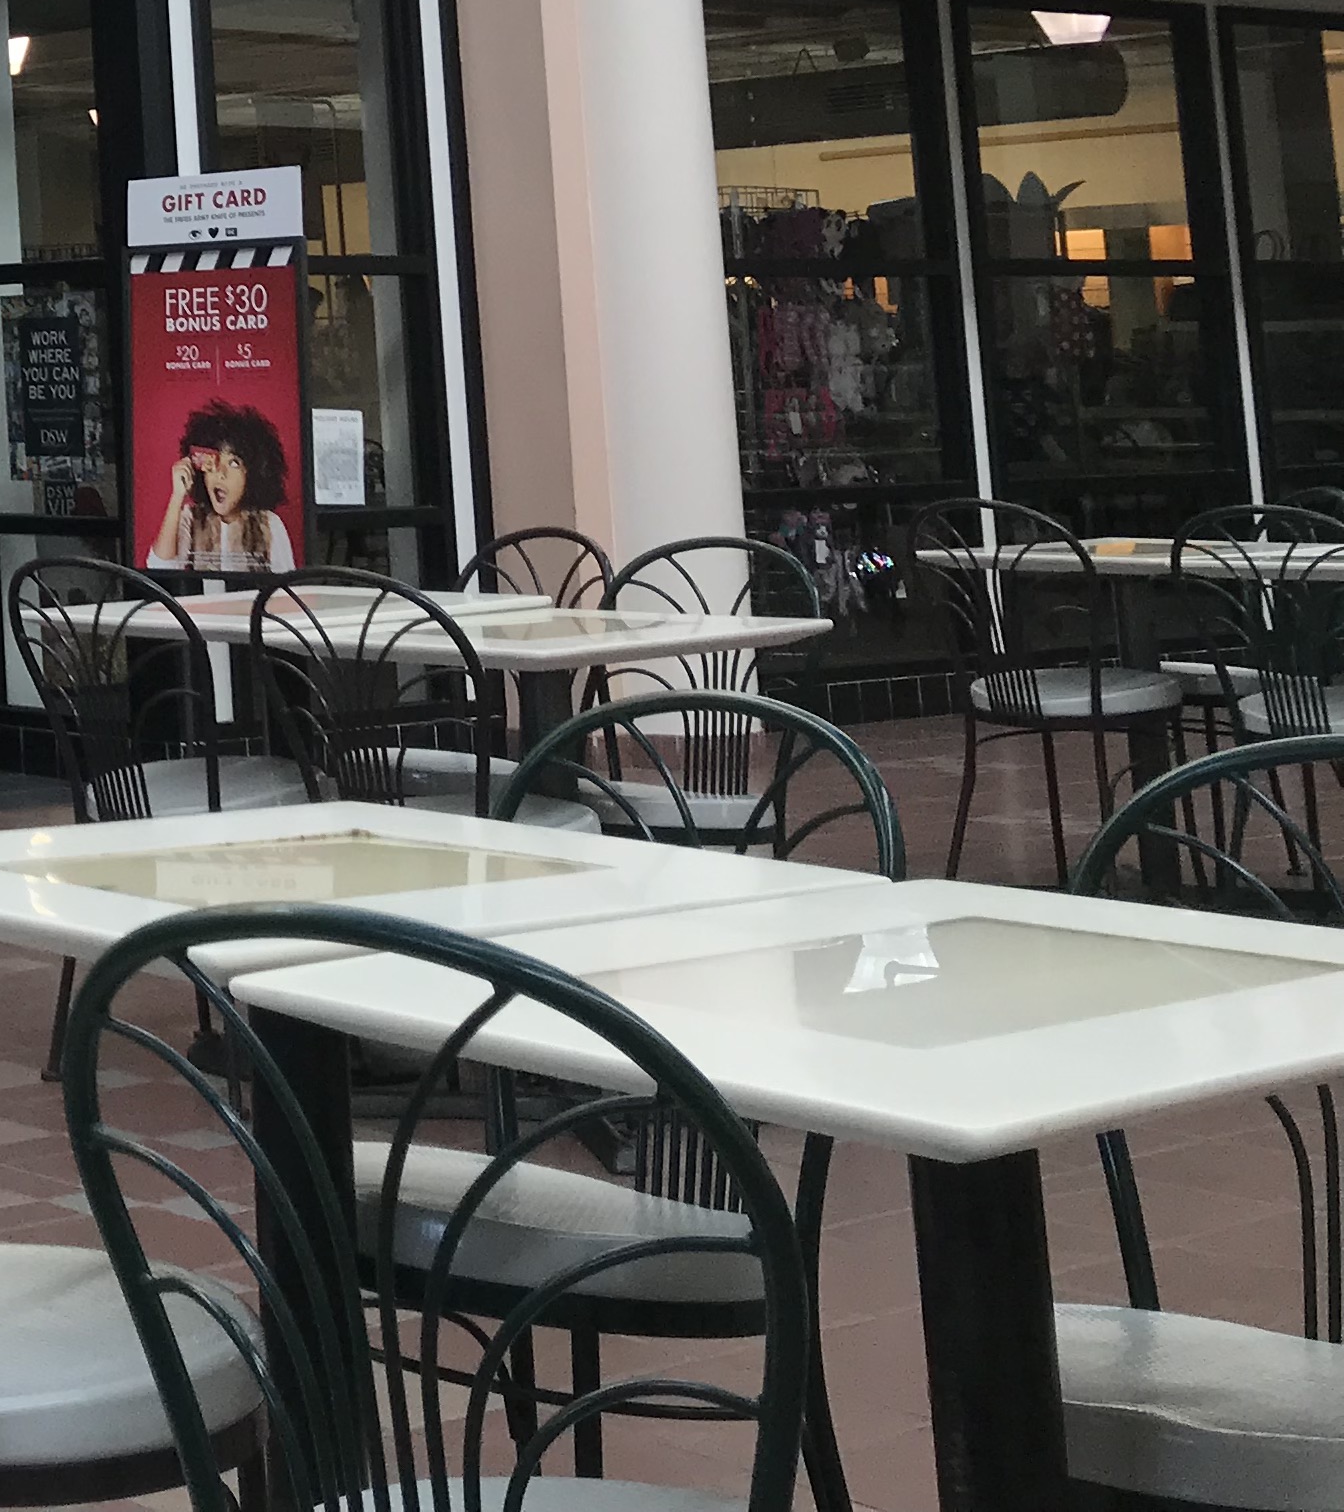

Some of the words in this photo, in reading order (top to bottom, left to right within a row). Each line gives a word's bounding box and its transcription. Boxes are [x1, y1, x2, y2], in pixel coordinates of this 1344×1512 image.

[162, 192, 205, 212] GIFT
[212, 187, 267, 209] CARD
[165, 286, 221, 316] FREE
[225, 283, 268, 314] $30
[165, 316, 221, 332] BONUS
[226, 314, 269, 330] CARD
[30, 330, 69, 346] WORK
[27, 348, 72, 364] WHERE
[176, 344, 200, 361] $20
[237, 343, 253, 360] $5
[22, 367, 48, 382] YOU
[52, 366, 80, 382] CAN
[28, 385, 47, 400] BE
[48, 384, 77, 400] YOU
[40, 429, 69, 445] DSW
[46, 485, 76, 499] DSW
[46, 498, 77, 516] VIP
